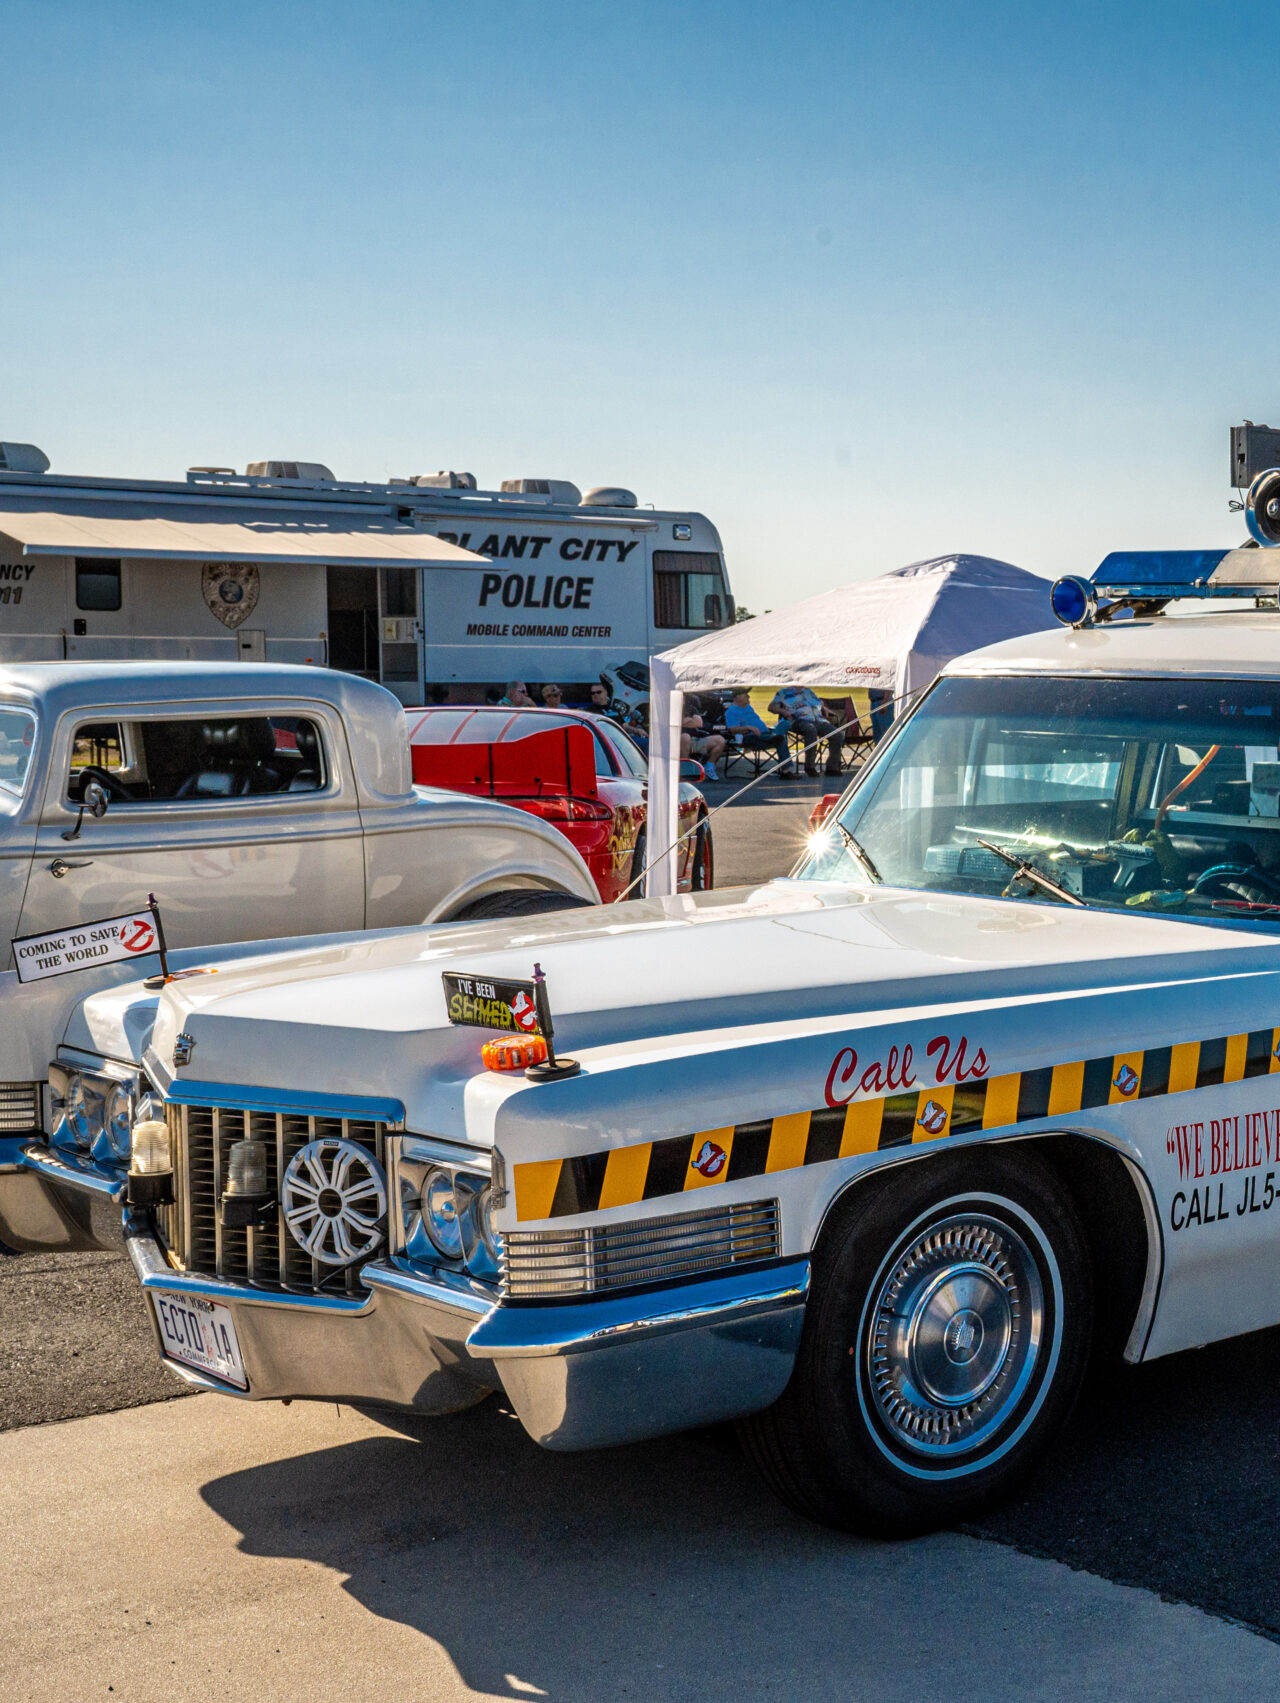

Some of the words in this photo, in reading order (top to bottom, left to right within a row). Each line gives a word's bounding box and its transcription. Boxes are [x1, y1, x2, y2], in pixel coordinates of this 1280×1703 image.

[559, 538, 640, 562] CITY
[478, 573, 594, 609] POLICE
[466, 623, 509, 636] MOBILE
[512, 624, 569, 637] COMMAND
[571, 625, 612, 638] CENTER
[19, 940, 66, 959] COMING
[69, 934, 86, 947] TO
[90, 926, 120, 942] SAVE
[36, 955, 62, 970] THE
[64, 944, 109, 963] WORLD
[457, 979, 474, 995] I'VE
[475, 981, 496, 999] BEEN
[449, 993, 512, 1027] SLIMED
[824, 1043, 917, 1107] Call
[926, 1035, 990, 1082] Us
[1170, 1182, 1229, 1231] CALL
[159, 1299, 204, 1353] ECTO
[211, 1320, 236, 1367] 1A
